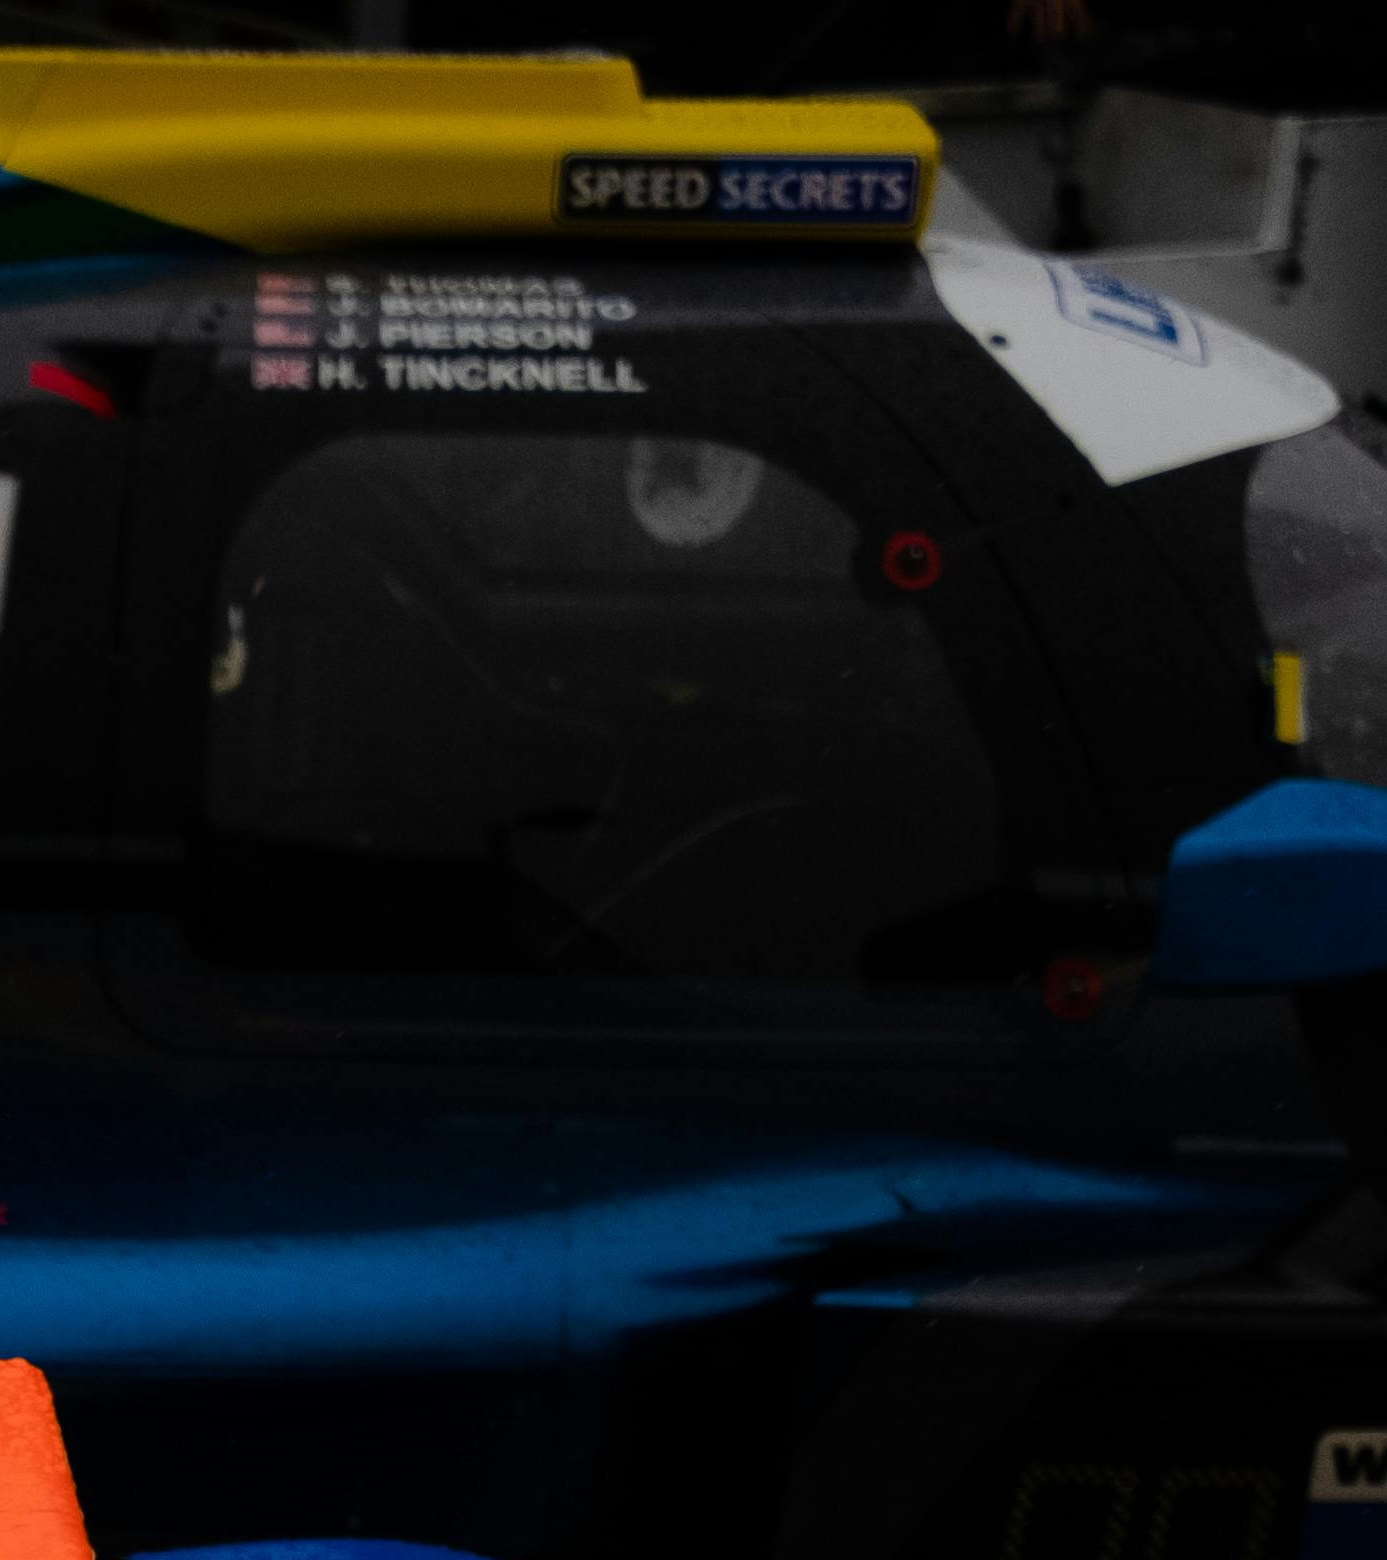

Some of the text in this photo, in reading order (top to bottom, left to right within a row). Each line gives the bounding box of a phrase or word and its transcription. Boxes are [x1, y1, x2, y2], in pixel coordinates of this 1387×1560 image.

[569, 166, 911, 213] SPEED SECRETS
[379, 320, 593, 350] PIERSON
[318, 355, 649, 392] H. TINCKNELL
